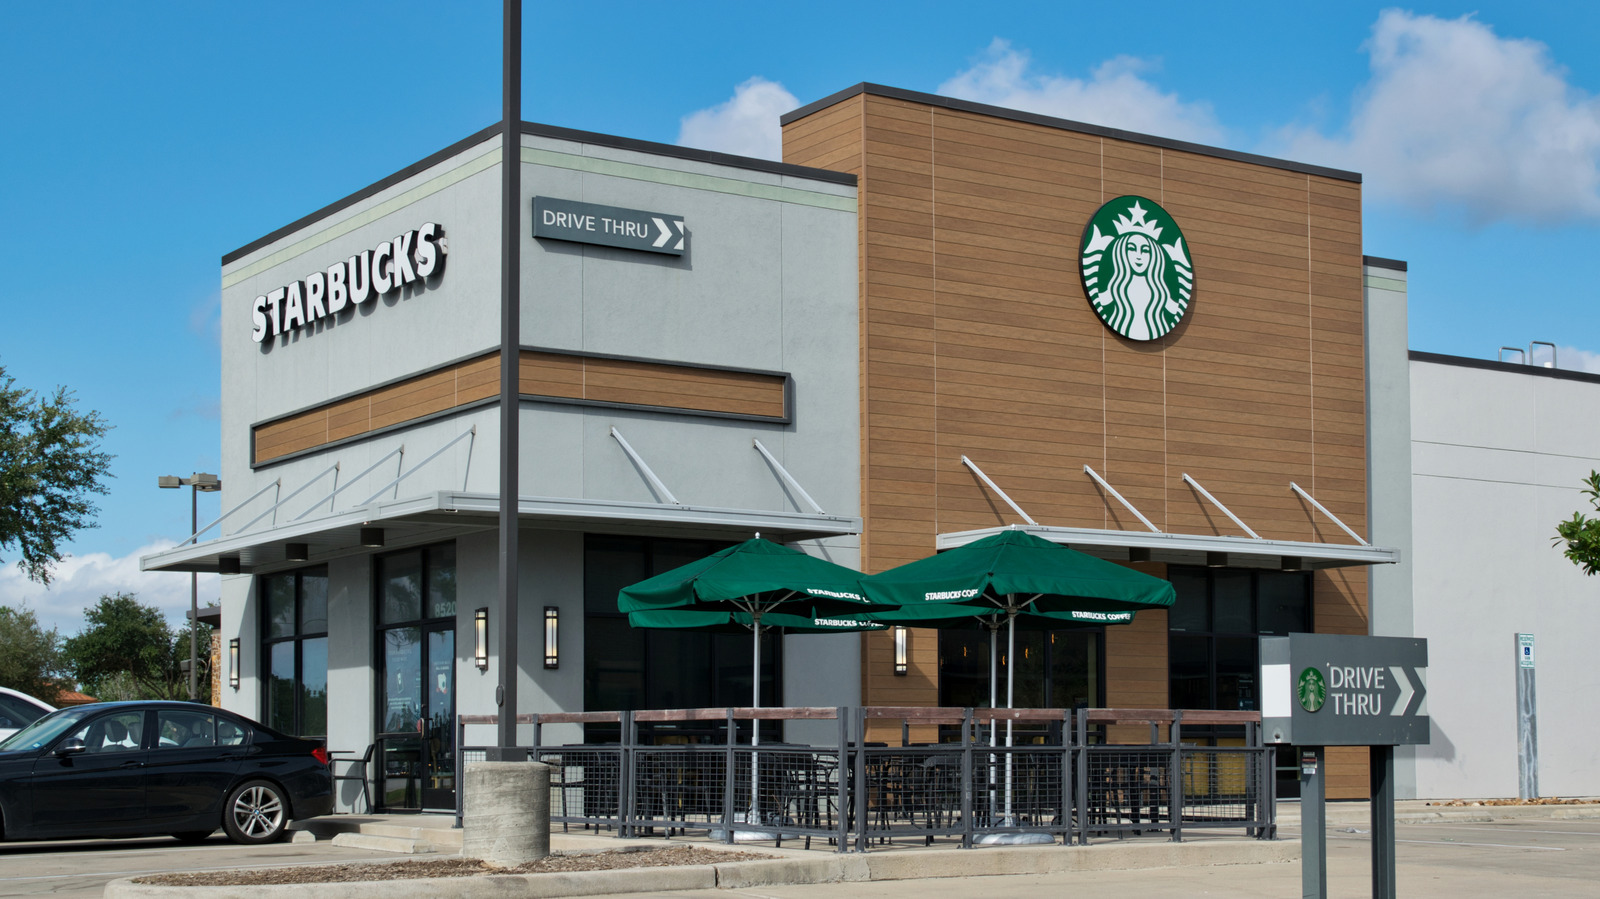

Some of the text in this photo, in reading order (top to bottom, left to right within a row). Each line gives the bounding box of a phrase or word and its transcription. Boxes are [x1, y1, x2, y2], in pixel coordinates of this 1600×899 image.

[543, 209, 649, 239] DRIVE THRU
[251, 222, 437, 343] STARBUCKS
[806, 588, 861, 601] STARBUCKS
[924, 590, 961, 601] STARBUCKS
[814, 618, 858, 627] STARBUCKS
[1071, 610, 1106, 621] STARBUCKS
[1330, 666, 1385, 689] DRIVE
[1331, 693, 1382, 716] THRU
